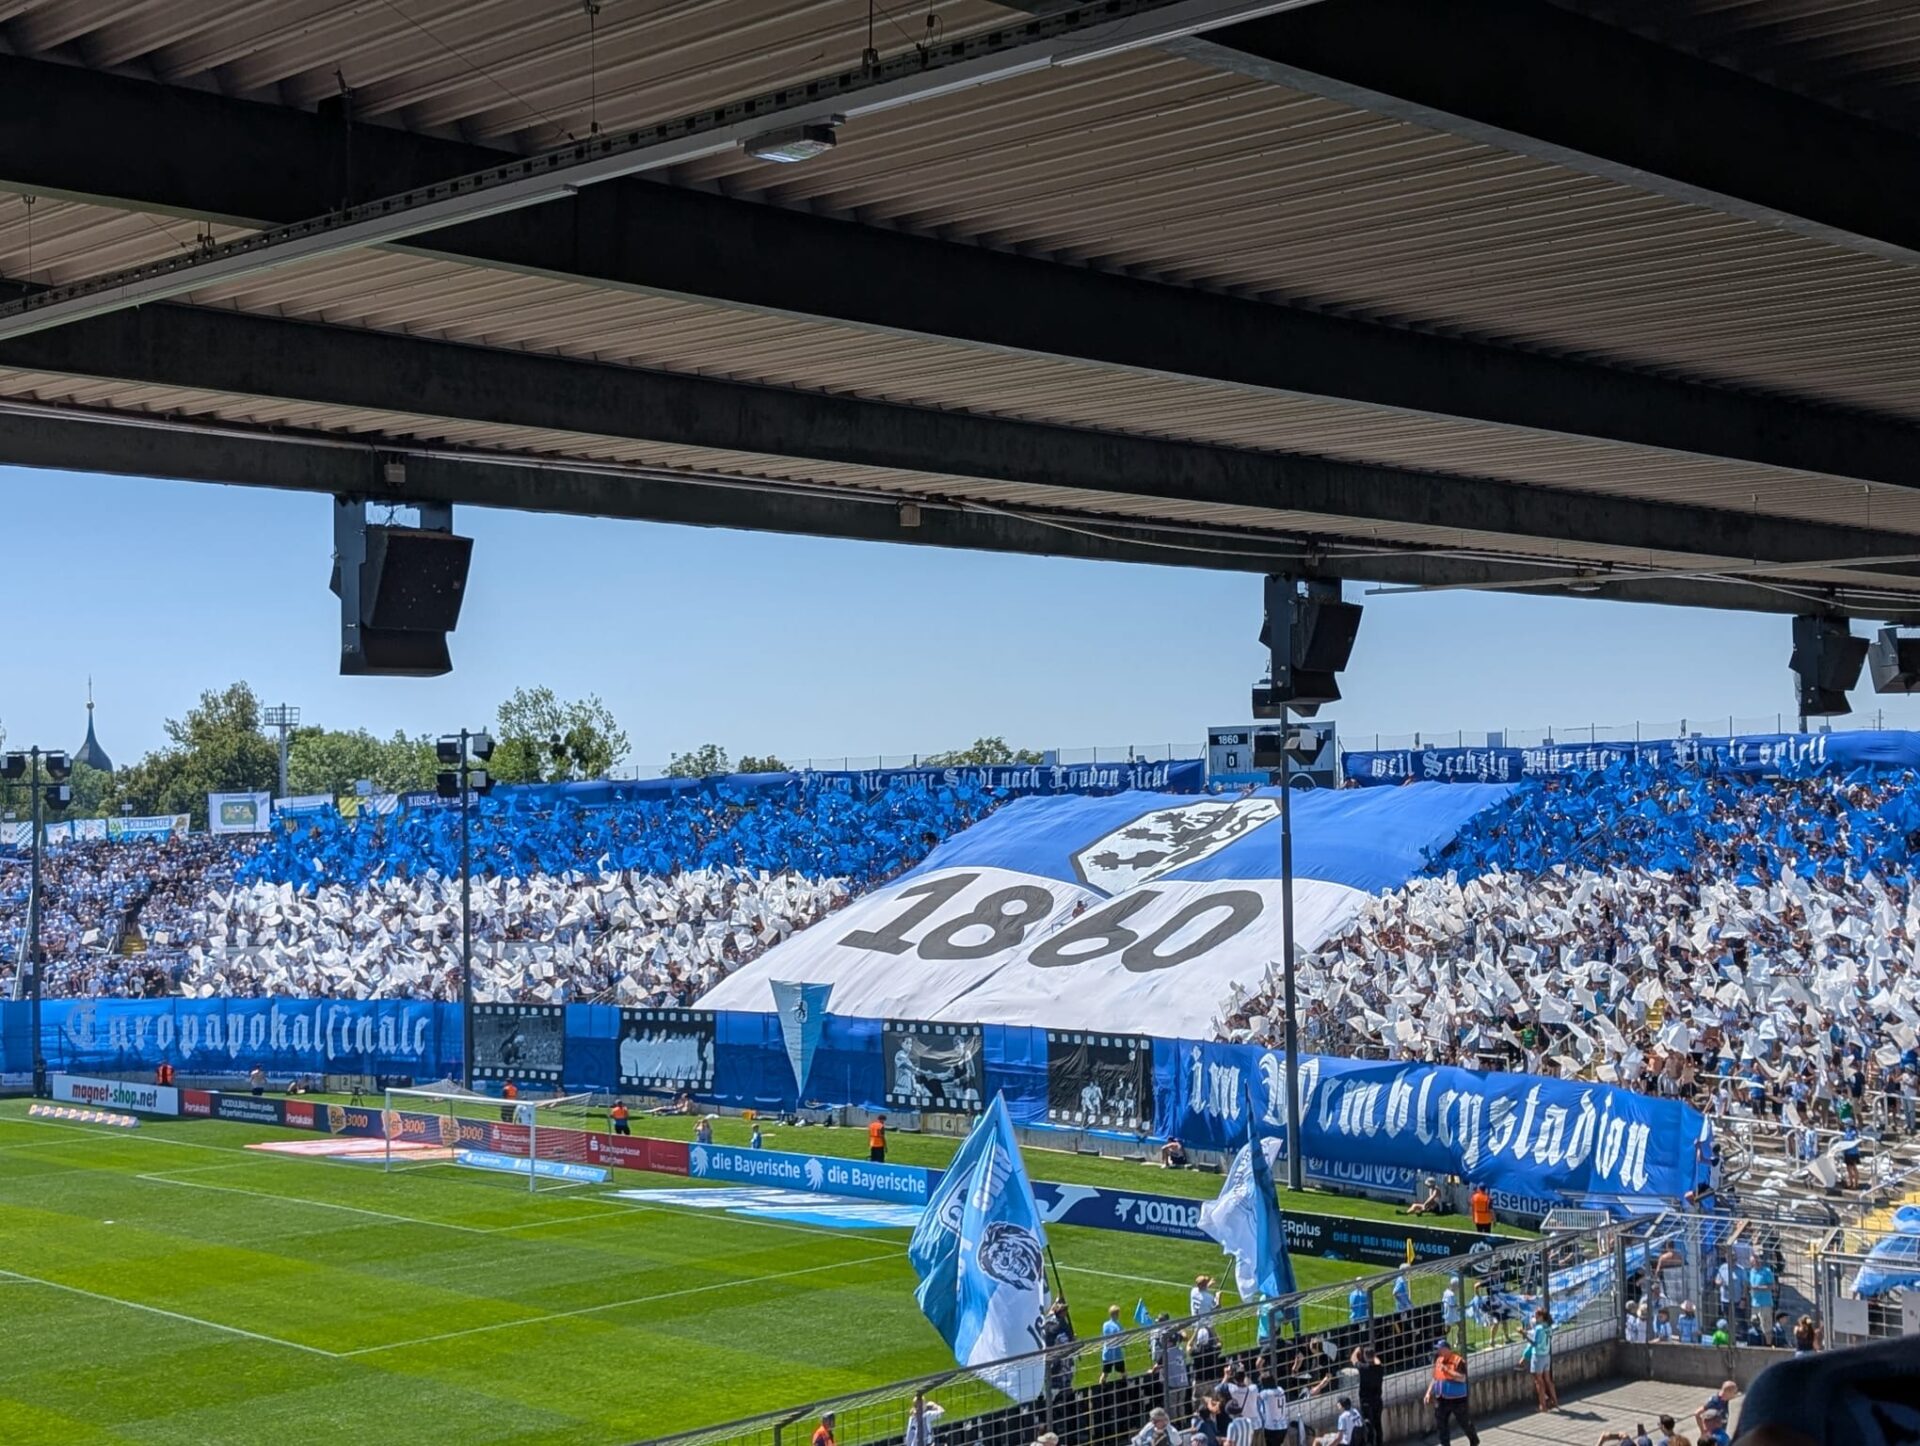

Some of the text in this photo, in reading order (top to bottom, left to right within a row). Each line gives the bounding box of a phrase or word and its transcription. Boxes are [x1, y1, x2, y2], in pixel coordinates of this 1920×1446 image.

[1218, 734, 1239, 745] 1860
[1228, 755, 1235, 767] 0
[1371, 752, 1415, 778] weil
[1422, 749, 1509, 783] Sechzig
[1000, 765, 1041, 789] nach
[1049, 763, 1120, 791] London
[840, 872, 1264, 973] 1860
[65, 1002, 431, 1061] Europapokalfinale
[72, 1082, 158, 1109] magnet-shop.net
[1188, 1045, 1241, 1121] im
[1258, 1051, 1651, 1193] Wembleystadion
[712, 1152, 731, 1171] die
[734, 1155, 801, 1180] Bayerische
[827, 1165, 927, 1194] die Bayerische
[1333, 1231, 1350, 1243] DIE
[1363, 1235, 1379, 1247] BEI
[1380, 1237, 1451, 1257] TRINWASSER
